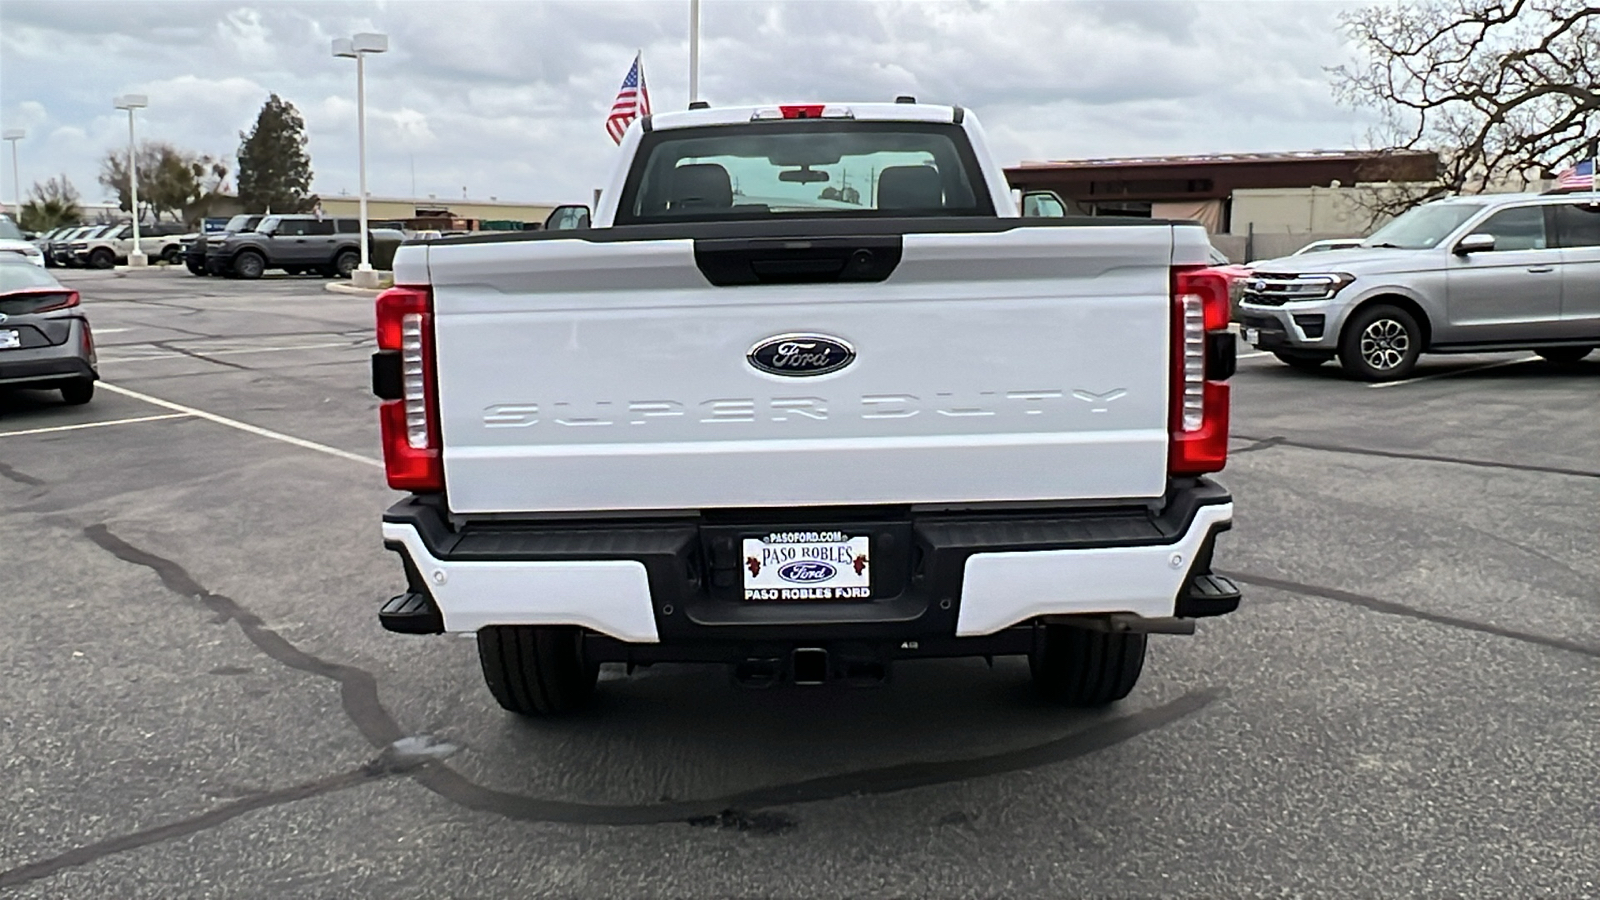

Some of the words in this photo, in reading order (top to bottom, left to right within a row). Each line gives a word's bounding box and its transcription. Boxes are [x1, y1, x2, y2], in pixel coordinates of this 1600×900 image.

[772, 342, 830, 367] Ford
[483, 396, 829, 428] SUPER
[861, 388, 1128, 419] DUTY
[770, 531, 842, 543] PASOFORD.COM
[762, 547, 796, 566] PASO
[802, 546, 853, 566] ROBLES
[790, 565, 825, 579] Ford
[745, 590, 778, 600] PASO
[782, 588, 832, 599] ROBLES
[835, 587, 870, 598] FORD
